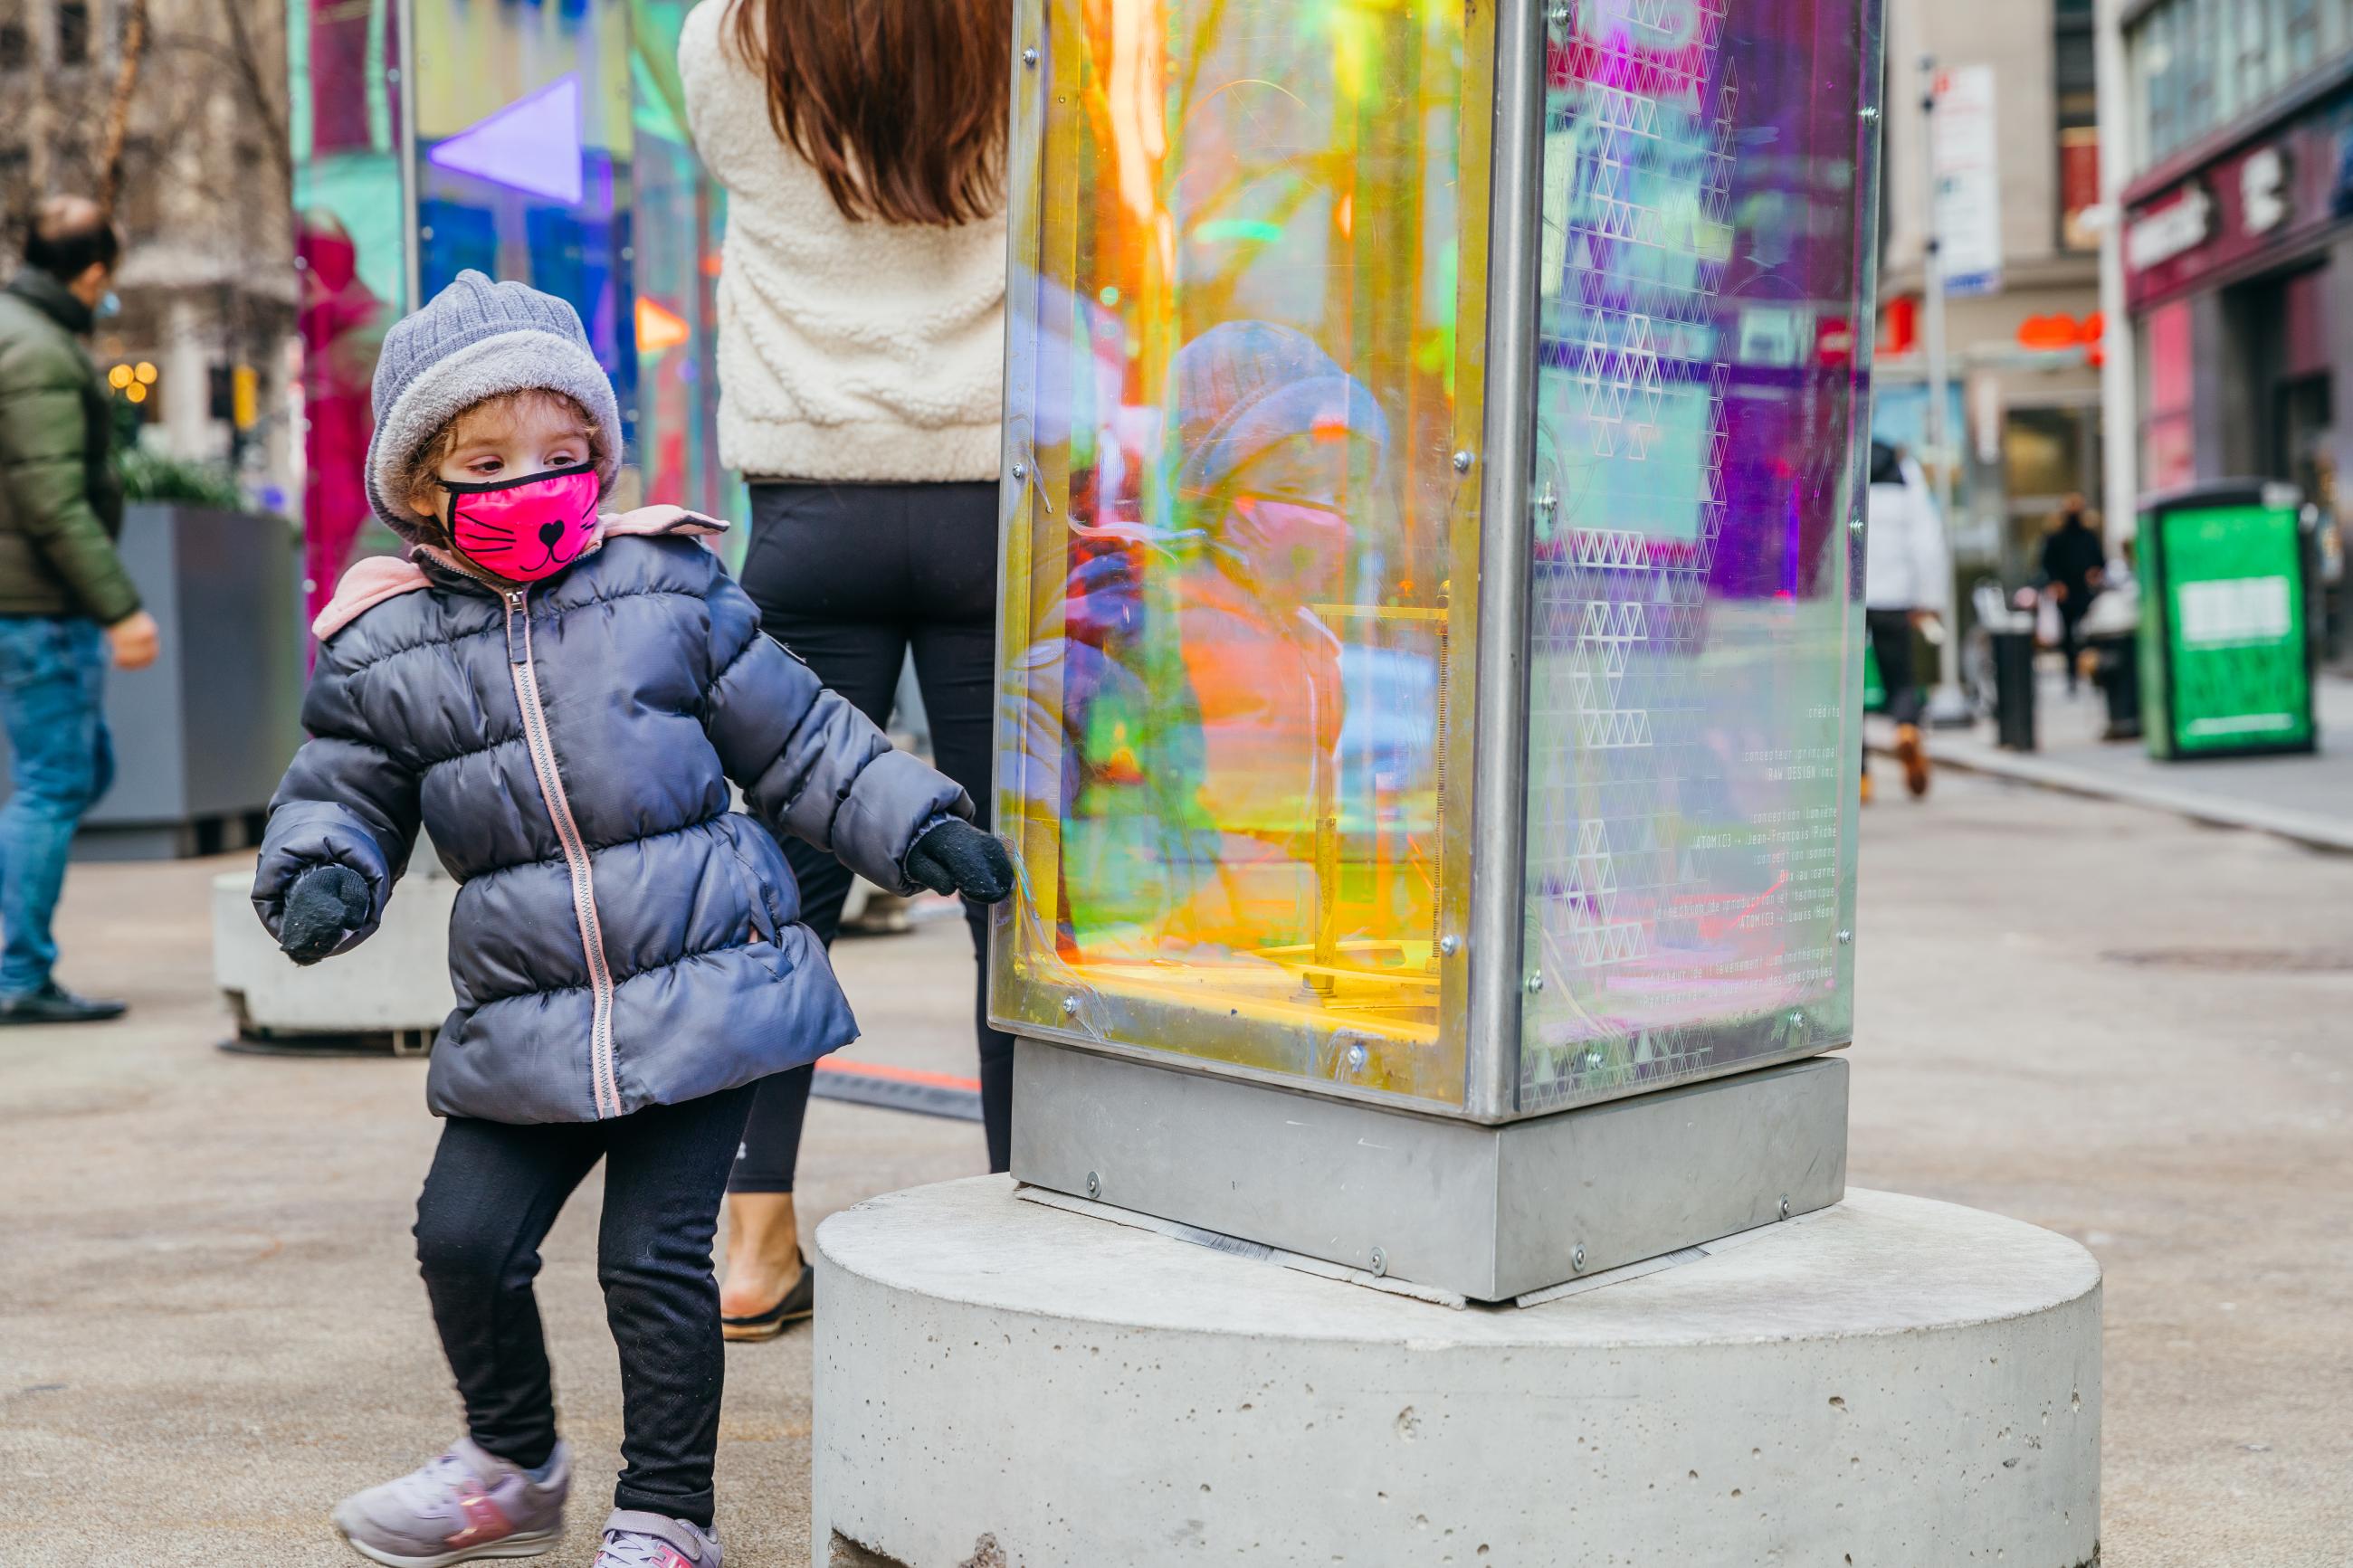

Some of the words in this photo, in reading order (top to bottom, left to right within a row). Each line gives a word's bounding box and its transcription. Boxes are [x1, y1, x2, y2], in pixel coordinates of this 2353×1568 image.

[1808, 704, 1840, 718] crédits
[1797, 745, 1838, 761] principal
[1767, 766, 1783, 781] RAW
[1787, 765, 1815, 780] DESIGN
